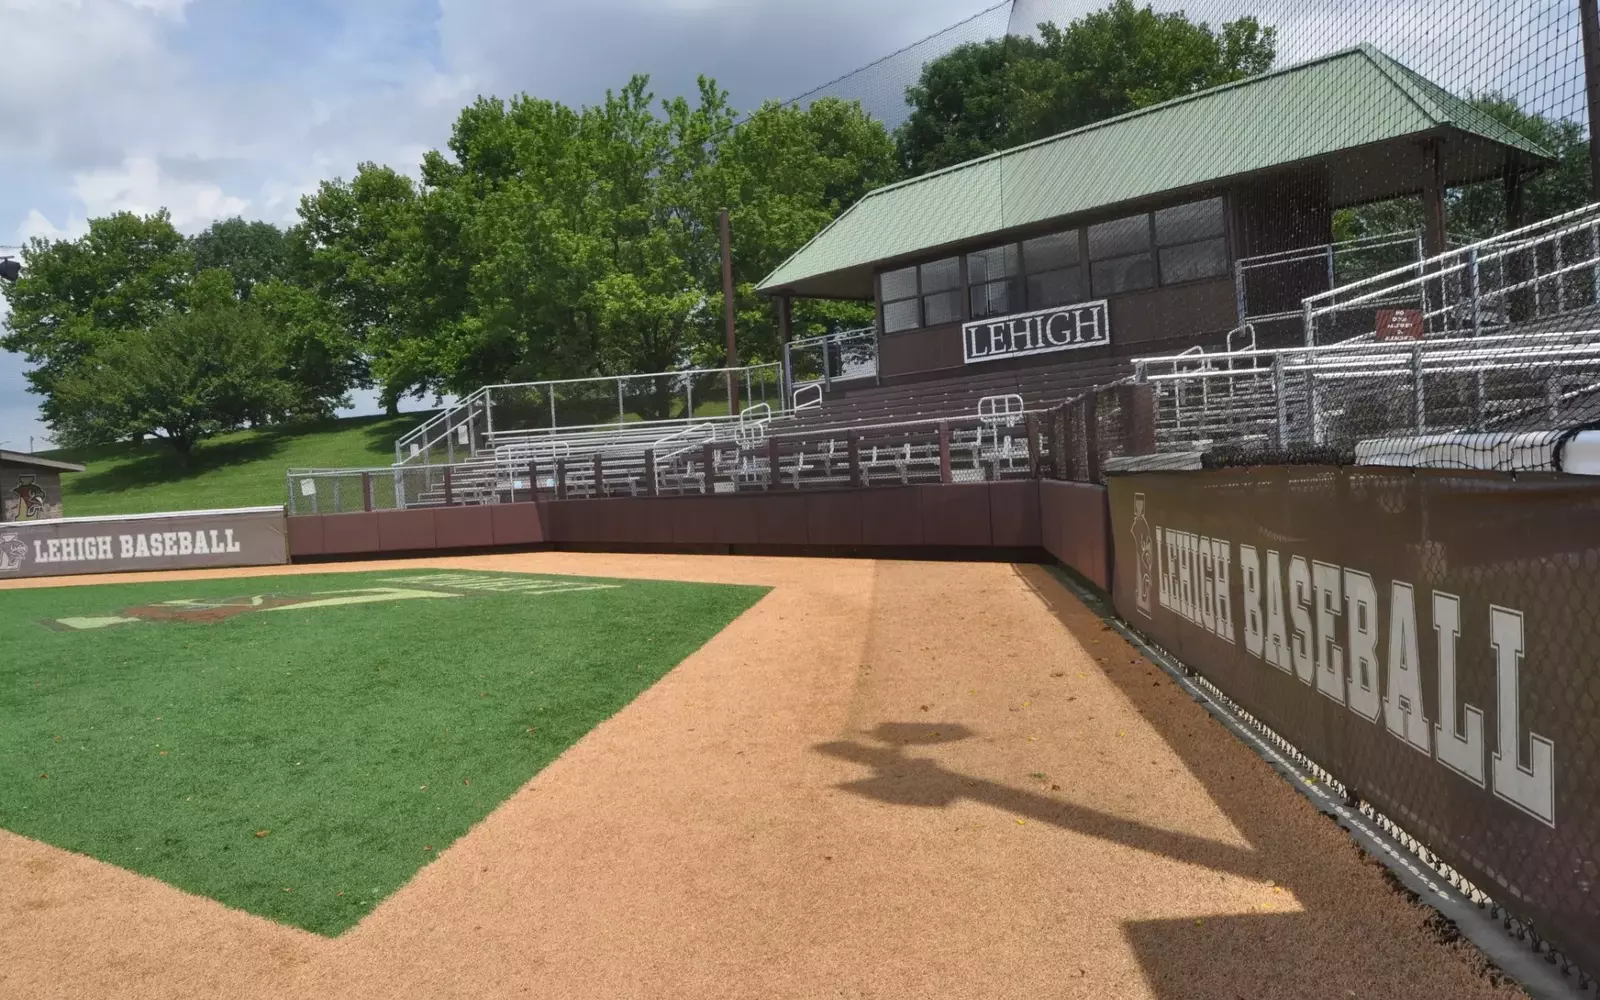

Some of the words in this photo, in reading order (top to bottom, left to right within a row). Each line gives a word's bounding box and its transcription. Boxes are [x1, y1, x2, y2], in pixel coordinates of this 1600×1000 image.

[967, 306, 1102, 358] LEHIGH
[34, 535, 114, 563] LEHIGH
[119, 528, 241, 559] BASEBALL
[1155, 525, 1236, 644] LEHIGH
[1240, 543, 1556, 829] BASEBALL
